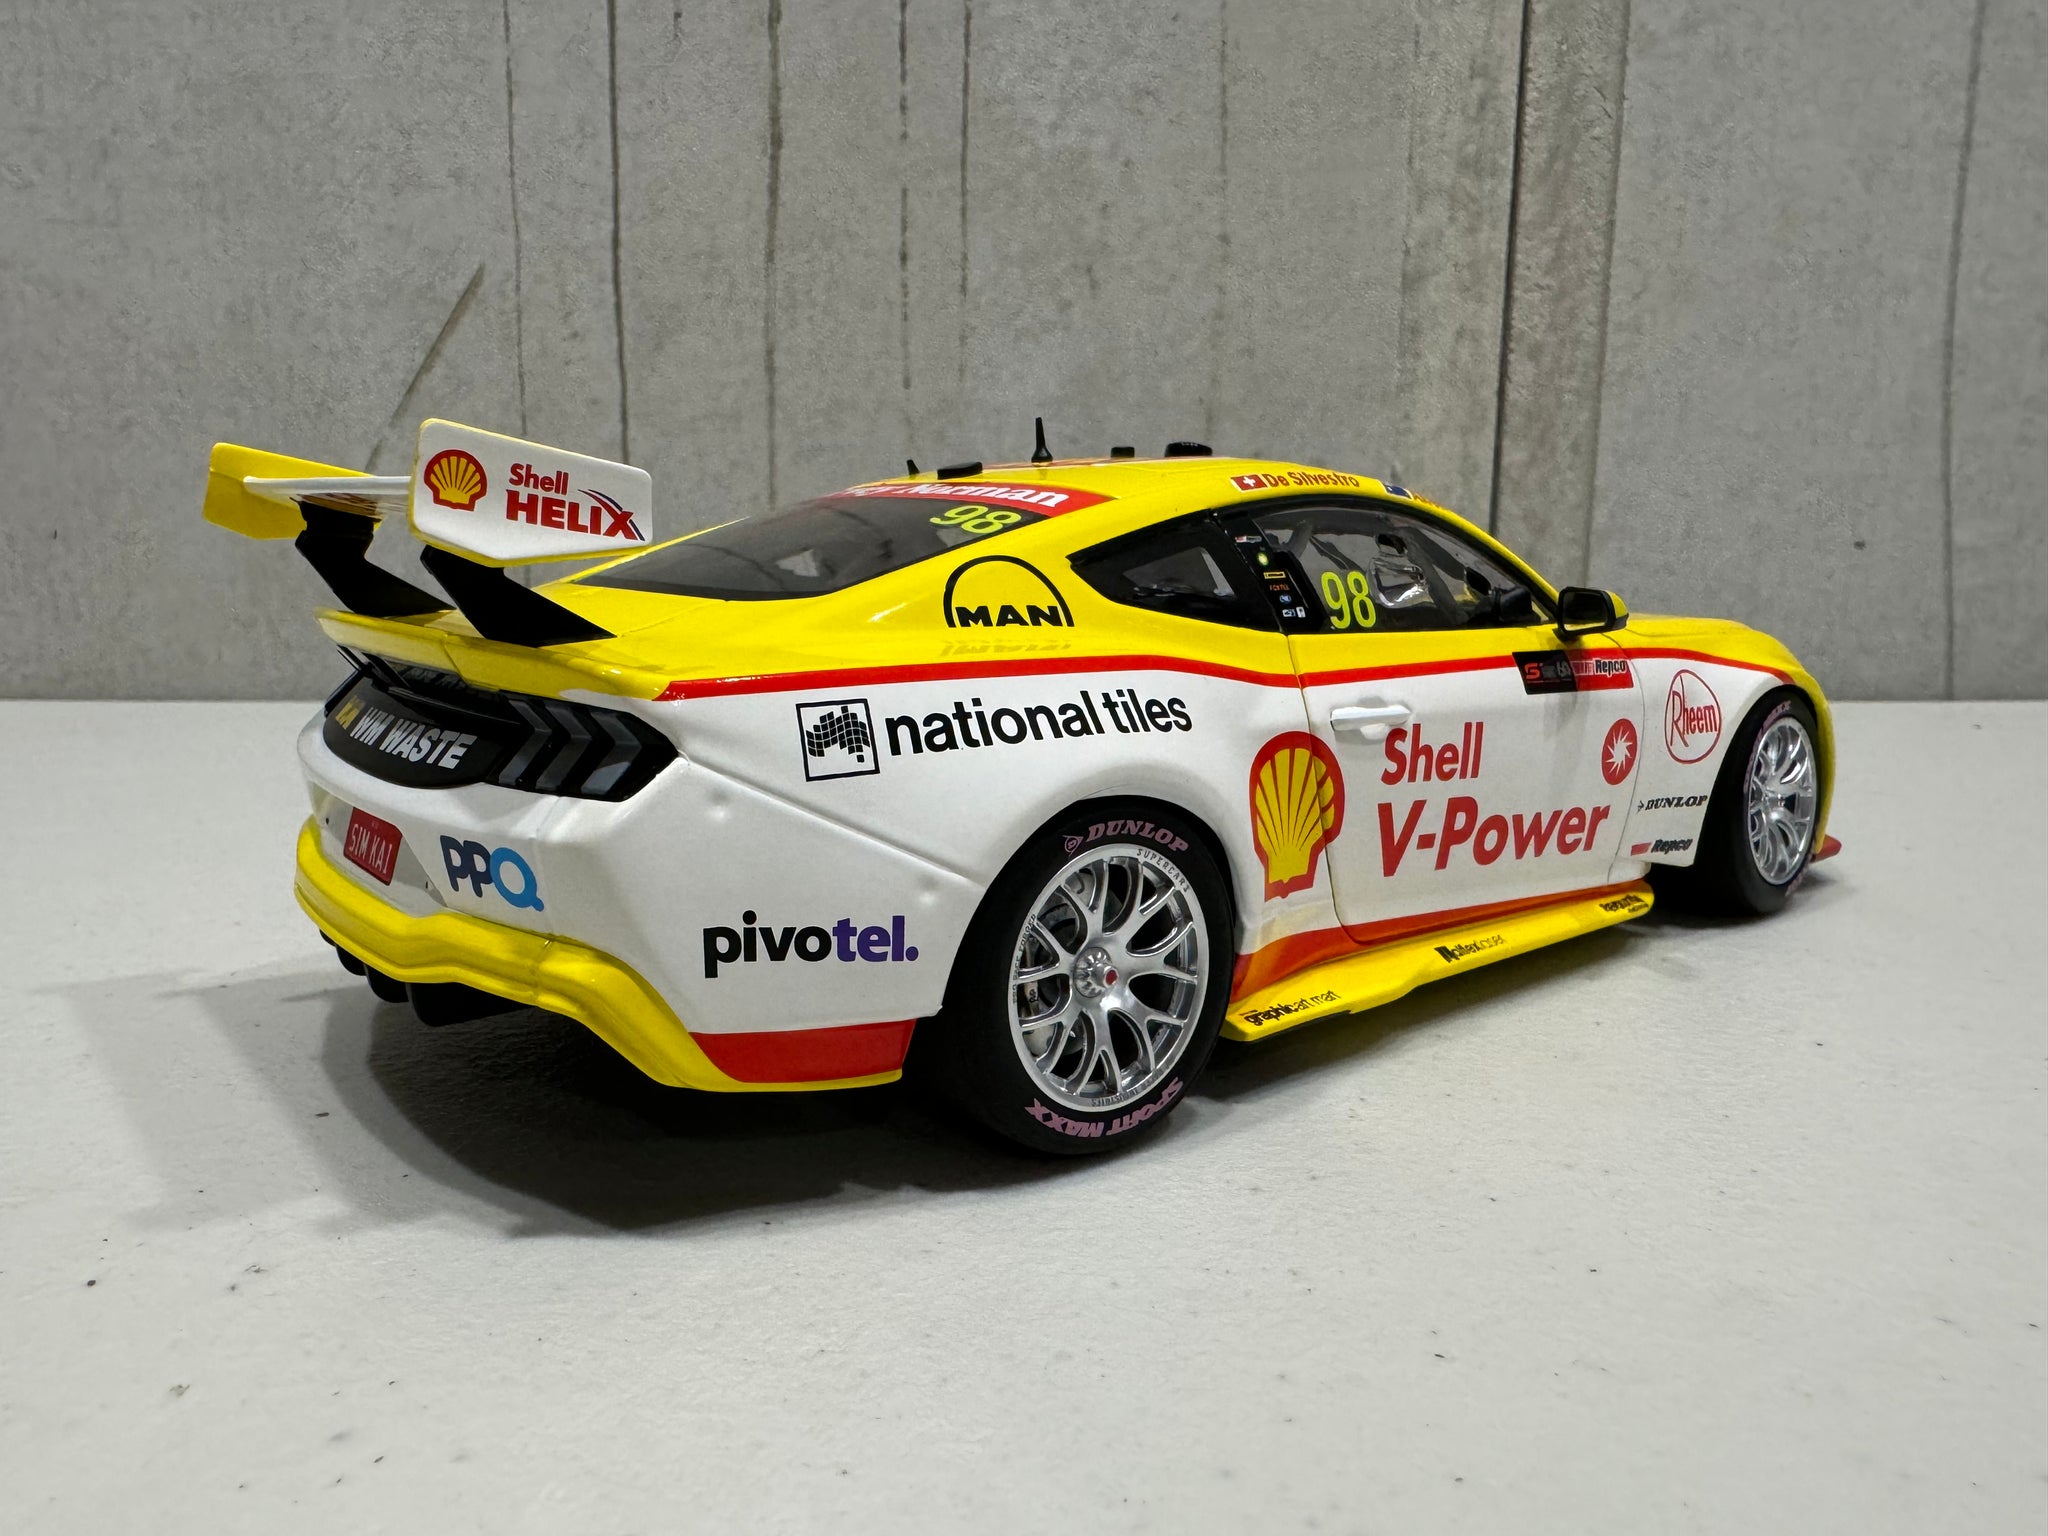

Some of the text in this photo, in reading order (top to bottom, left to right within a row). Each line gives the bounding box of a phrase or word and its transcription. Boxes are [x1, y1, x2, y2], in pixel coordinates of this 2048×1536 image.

[509, 463, 569, 496] Shell
[1262, 472, 1360, 488] De Silvestro
[506, 489, 644, 541] HELIX
[930, 505, 1022, 534] 98
[955, 604, 1063, 627] MAN
[1321, 571, 1376, 629] 98
[1595, 659, 1626, 677] Repco
[885, 688, 1193, 756] national tiles
[1670, 689, 1719, 747] Rheem
[380, 720, 478, 769] WASTE
[1380, 722, 1484, 785] Shell
[1645, 795, 1708, 810] DUNLOP
[349, 823, 370, 860] SIM
[1086, 819, 1189, 851] DUNLOP
[1377, 796, 1611, 877] V-Power
[440, 835, 544, 912] PPQ
[1137, 848, 1190, 893] SUPERCARS
[1024, 1097, 1104, 1138] MAXX
